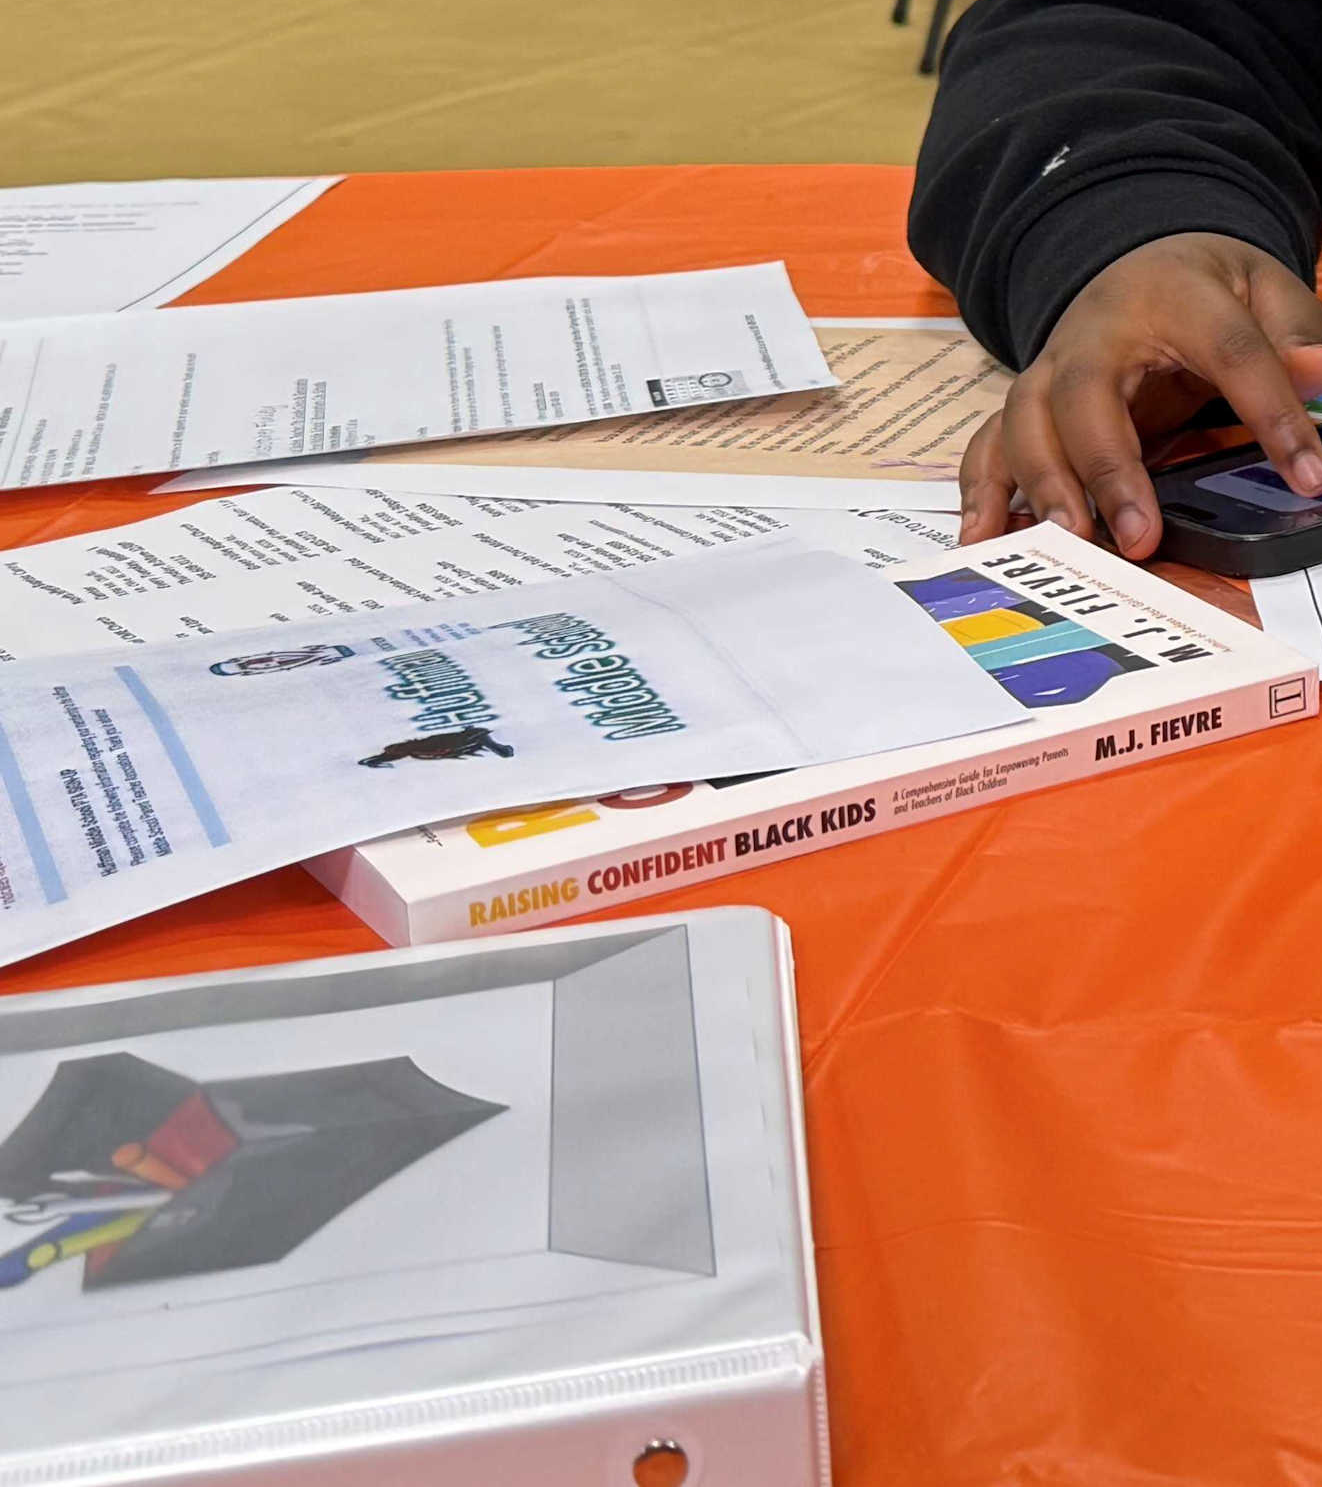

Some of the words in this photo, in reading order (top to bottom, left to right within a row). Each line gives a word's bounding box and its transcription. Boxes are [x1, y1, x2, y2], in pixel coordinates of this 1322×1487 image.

[981, 552, 1120, 616] FIEVRE
[1122, 617, 1214, 664] M.J.
[378, 648, 500, 732] Huffman
[556, 649, 687, 742] Middle
[1095, 730, 1144, 762] M.J.
[1151, 707, 1222, 746] FIEVRE
[893, 792, 899, 802] A
[901, 777, 957, 800] Comprehensive
[958, 770, 980, 785] Guide
[995, 755, 1040, 776] Empowering
[1042, 748, 1069, 762] Parents
[911, 794, 942, 811] Teachers
[955, 785, 976, 799] Black
[977, 777, 1008, 793] Children
[468, 877, 579, 928] RAISING
[587, 837, 728, 895] CONFIDENT
[735, 814, 814, 857] BLACK
[820, 798, 877, 833] KIDS
